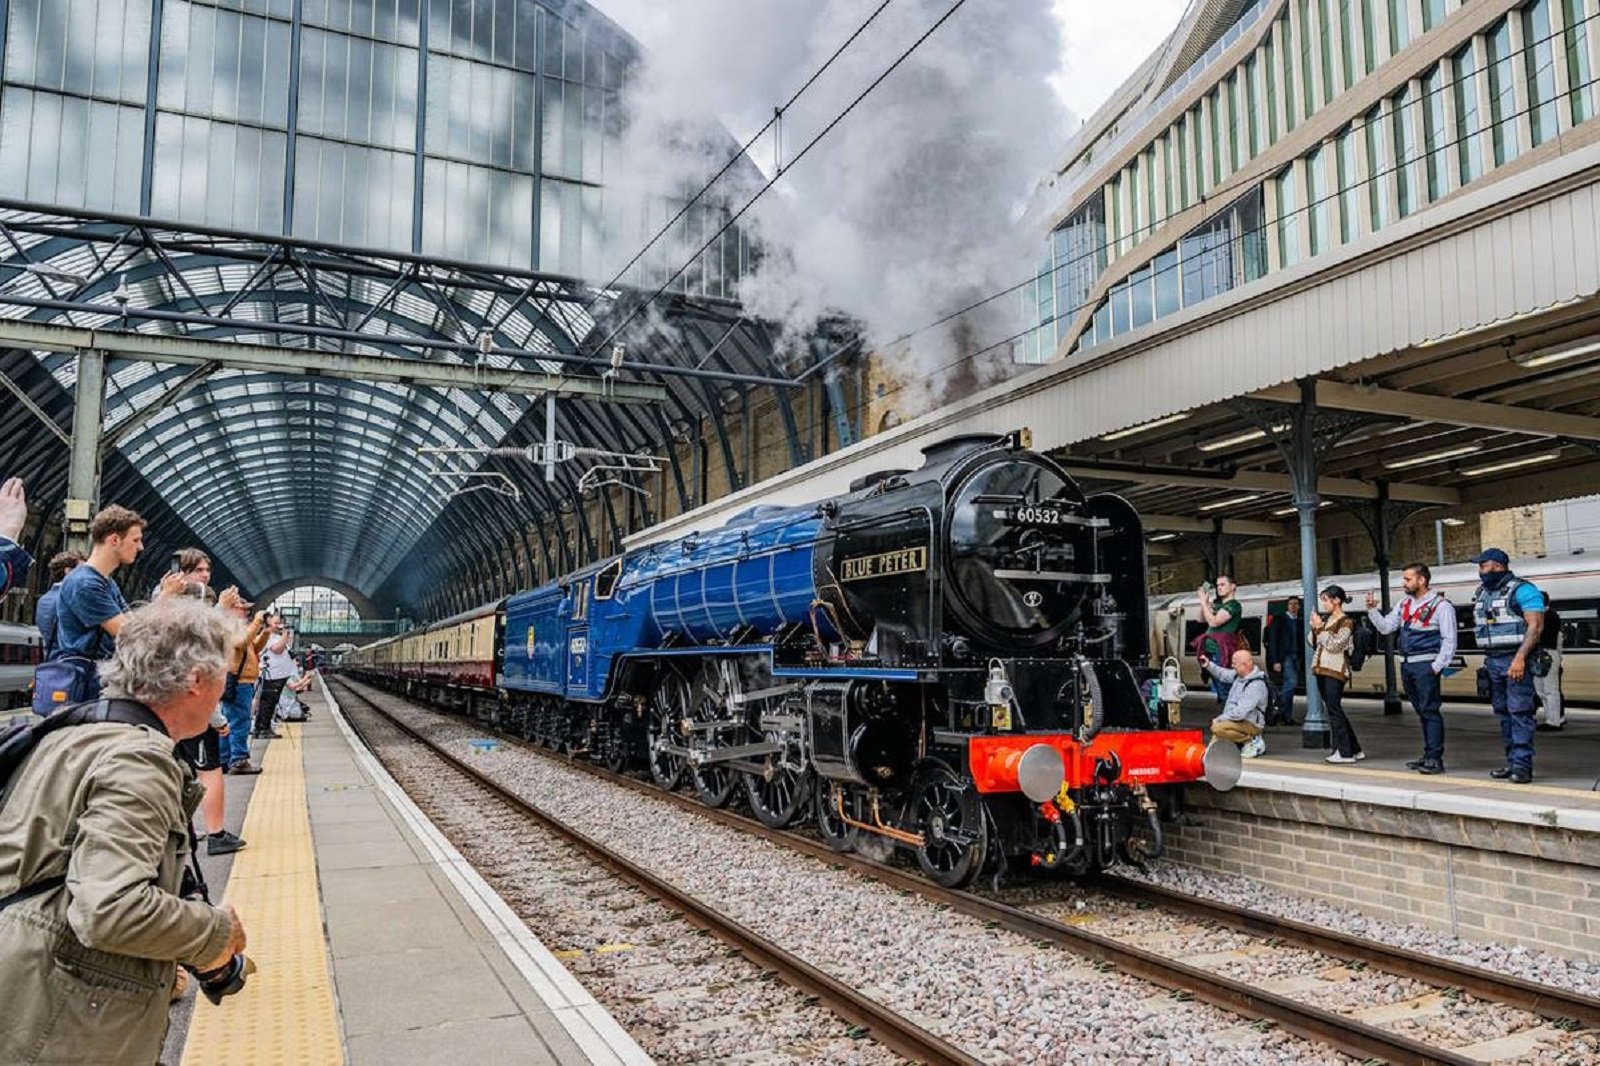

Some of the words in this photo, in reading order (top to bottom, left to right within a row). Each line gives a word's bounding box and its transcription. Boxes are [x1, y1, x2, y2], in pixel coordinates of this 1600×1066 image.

[1017, 507, 1059, 524] 60532
[845, 559, 872, 579] BLUE
[879, 551, 917, 573] PETER
